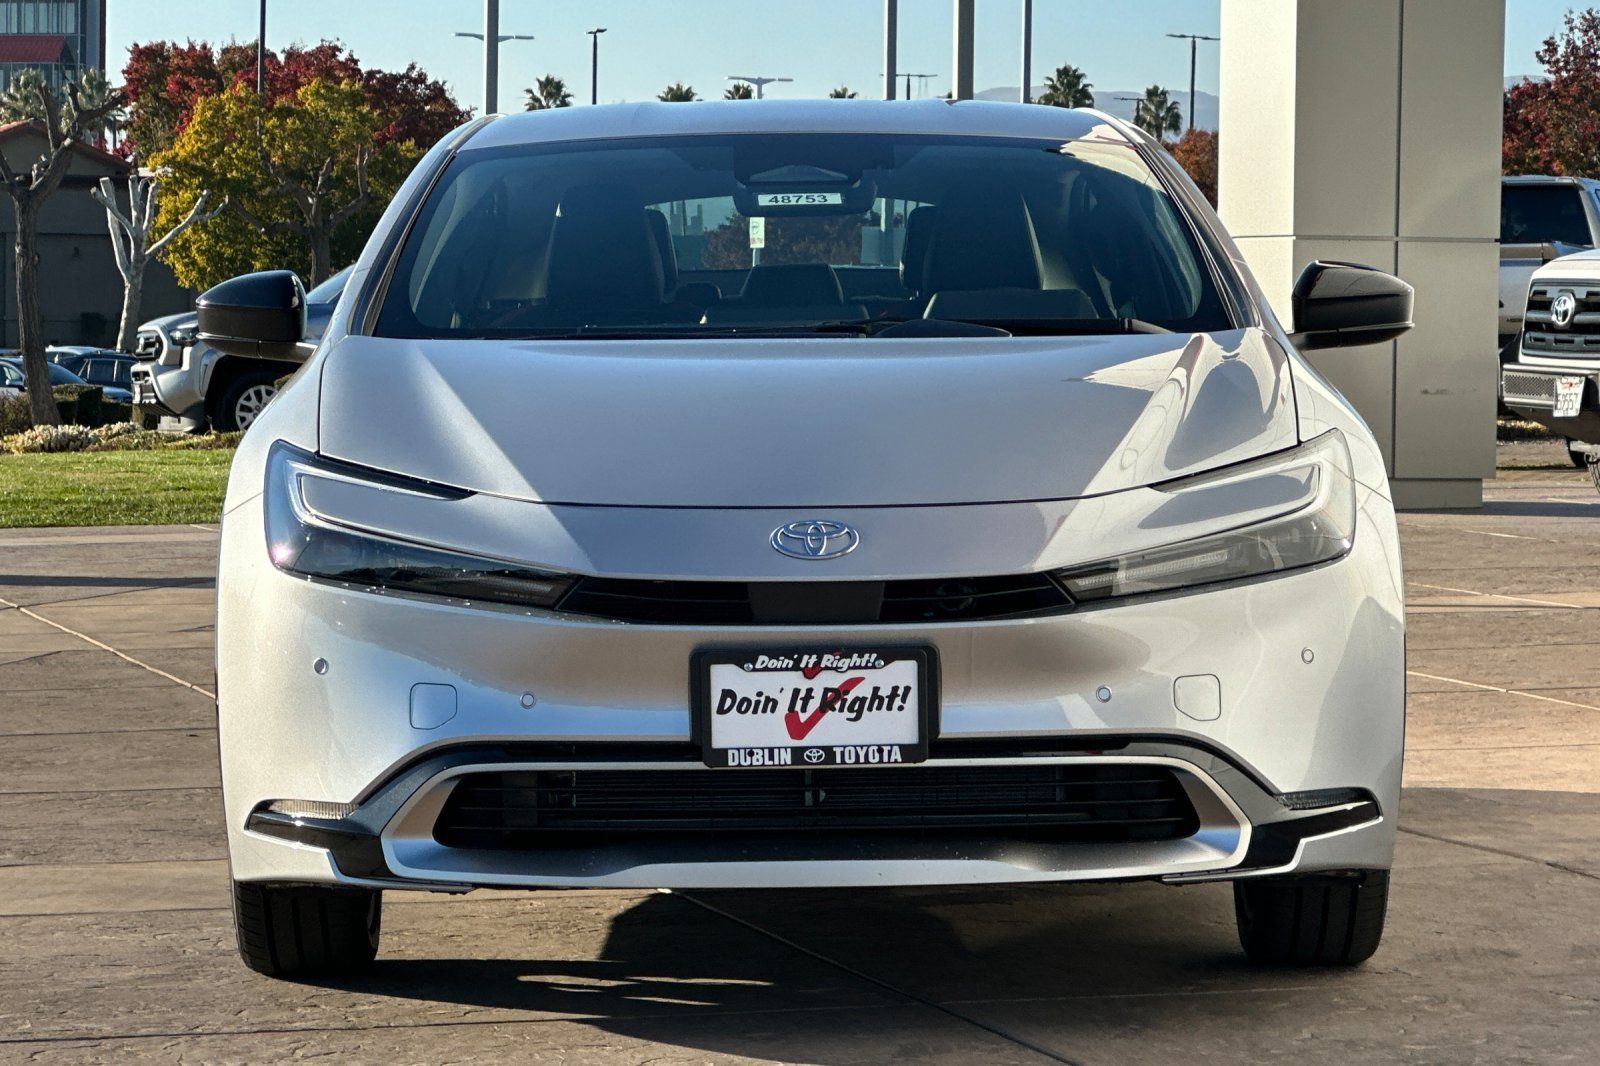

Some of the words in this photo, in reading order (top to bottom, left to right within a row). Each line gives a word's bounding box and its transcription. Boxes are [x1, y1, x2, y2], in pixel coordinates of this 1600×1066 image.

[768, 194, 828, 204] 48753
[755, 654, 797, 669] Doin'
[800, 654, 819, 668] It
[820, 653, 878, 673] Right!
[716, 687, 784, 715] Doin'
[788, 687, 815, 714] It
[818, 685, 912, 722] Right!
[728, 748, 791, 766] DUBLIN
[833, 745, 902, 764] TOYOTA
